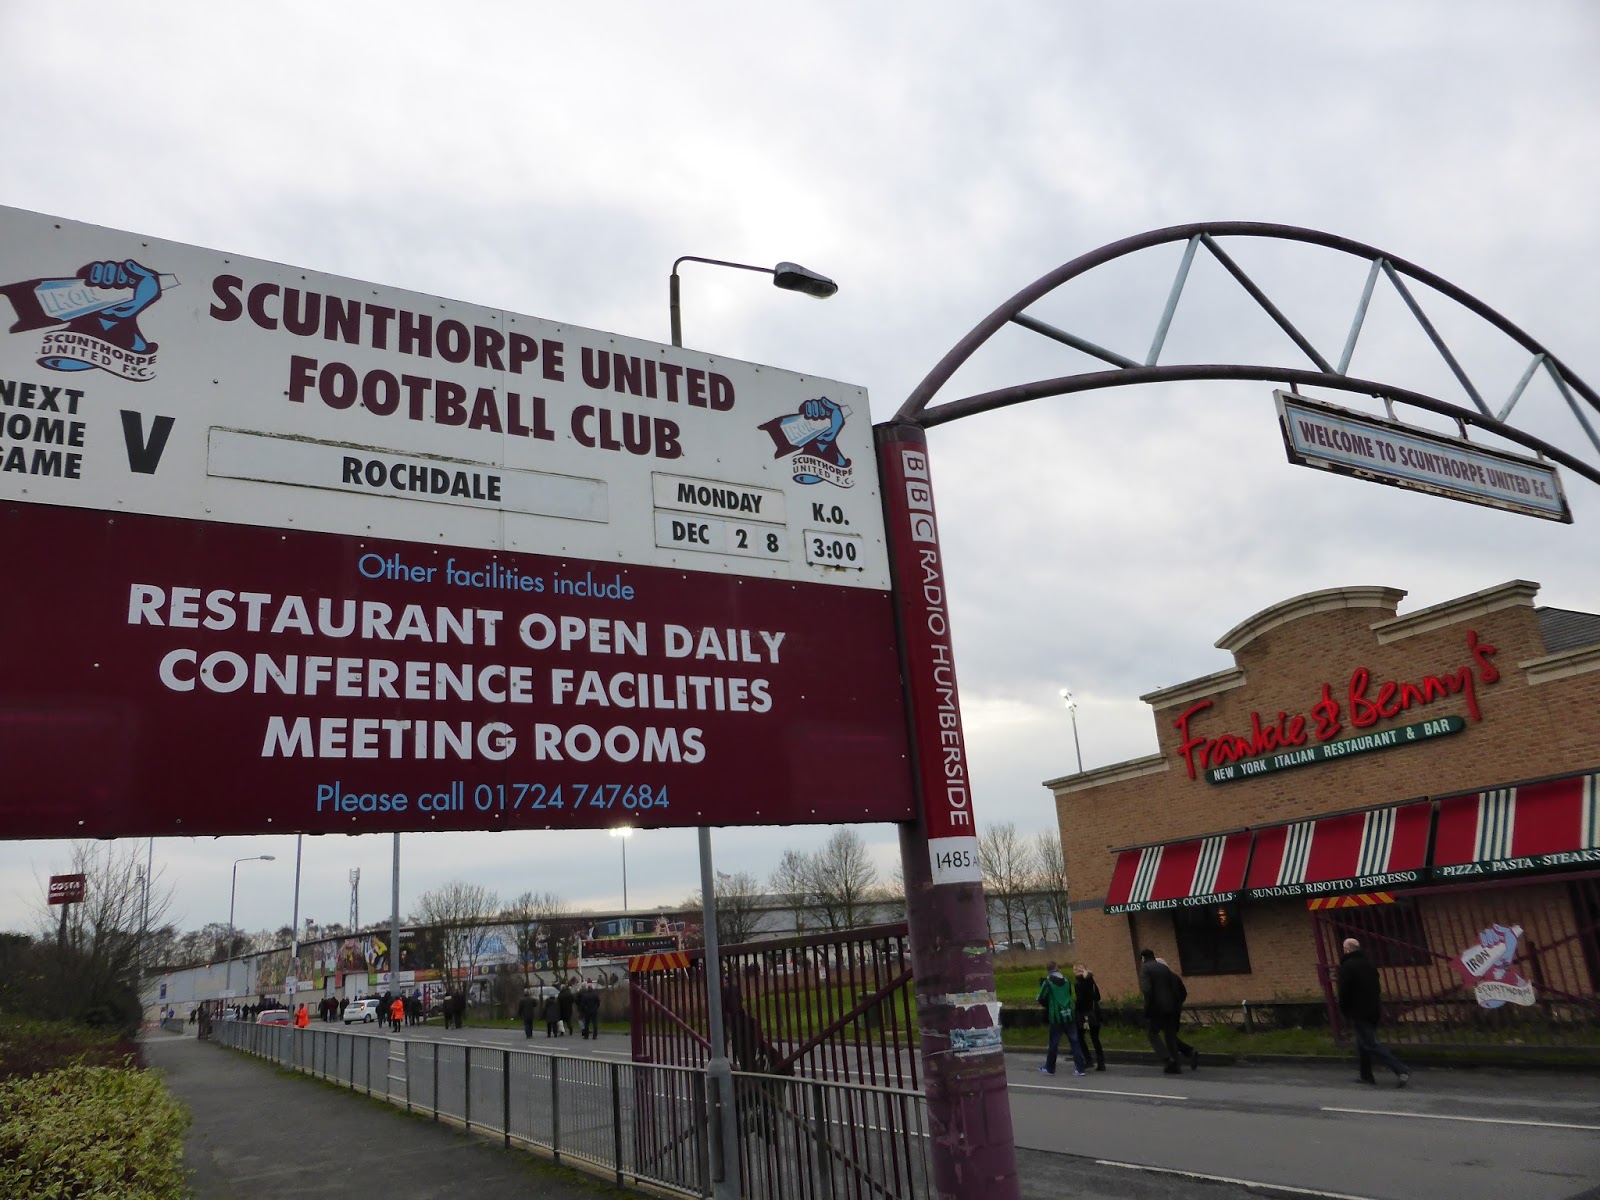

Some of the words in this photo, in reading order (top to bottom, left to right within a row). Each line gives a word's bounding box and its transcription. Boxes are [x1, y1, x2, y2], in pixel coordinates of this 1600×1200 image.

[41, 344, 112, 366] UNITED
[43, 333, 157, 366] SCUNTHORPE
[209, 274, 565, 382] SCUNTHORPE
[581, 346, 736, 412] UNITED
[288, 355, 555, 441] FOOTBALL
[571, 404, 684, 459] CLUB
[0, 412, 86, 447] OME
[120, 409, 176, 475] V
[0, 446, 83, 479] AME
[792, 456, 853, 477] SCUNTHORPE
[792, 464, 831, 479] UNITED
[1299, 420, 1373, 459] WELCOME
[1376, 440, 1397, 463] TO
[1399, 446, 1486, 484] SCUNTHORPE
[1488, 468, 1530, 495] UNITED
[342, 456, 501, 501] ROCHDALE
[677, 483, 763, 514] MONDAY
[902, 450, 936, 544] BBC
[812, 502, 850, 526] K.O.
[672, 521, 710, 546] DEC
[813, 538, 857, 561] 3:00
[358, 553, 438, 583] Other
[446, 557, 545, 593] facilities
[554, 571, 635, 600] include
[919, 549, 946, 636] RADIO
[127, 583, 504, 647] RESTAURANT
[519, 612, 648, 657] OPEN
[664, 624, 786, 664] DAILY
[159, 648, 533, 704] CONFERENCE
[551, 668, 773, 713] FACILITIES
[1174, 700, 1307, 780] Frankie
[1349, 630, 1500, 728] Benny's
[261, 716, 517, 761] MEETING
[535, 723, 706, 764] ROOMS
[930, 644, 969, 826] HUMBERSIDE
[1213, 766, 1234, 781] NEW
[1240, 758, 1267, 774] YORK
[1274, 748, 1316, 769] ITALIAN
[1323, 730, 1397, 758] RESTAURANT
[1406, 727, 1416, 740] &
[1423, 718, 1450, 735] BAR
[316, 781, 409, 812] Please
[417, 781, 464, 811] call
[474, 784, 564, 811] 01724
[572, 784, 669, 809] 747684
[936, 851, 970, 869] 1485
[1442, 863, 1483, 876] PIZZA
[1492, 858, 1534, 872] PASTA
[1542, 848, 1600, 866] STEAKS
[51, 881, 80, 891] COSTA
[1252, 884, 1301, 899] SUNDAES
[1305, 879, 1354, 893] RISOTTO
[1359, 871, 1417, 887] ESPRESSO
[1109, 903, 1141, 914] SALADS
[1146, 899, 1177, 910] GRILLS
[1182, 892, 1233, 906] COCKTAILS
[1466, 949, 1491, 973] IRON
